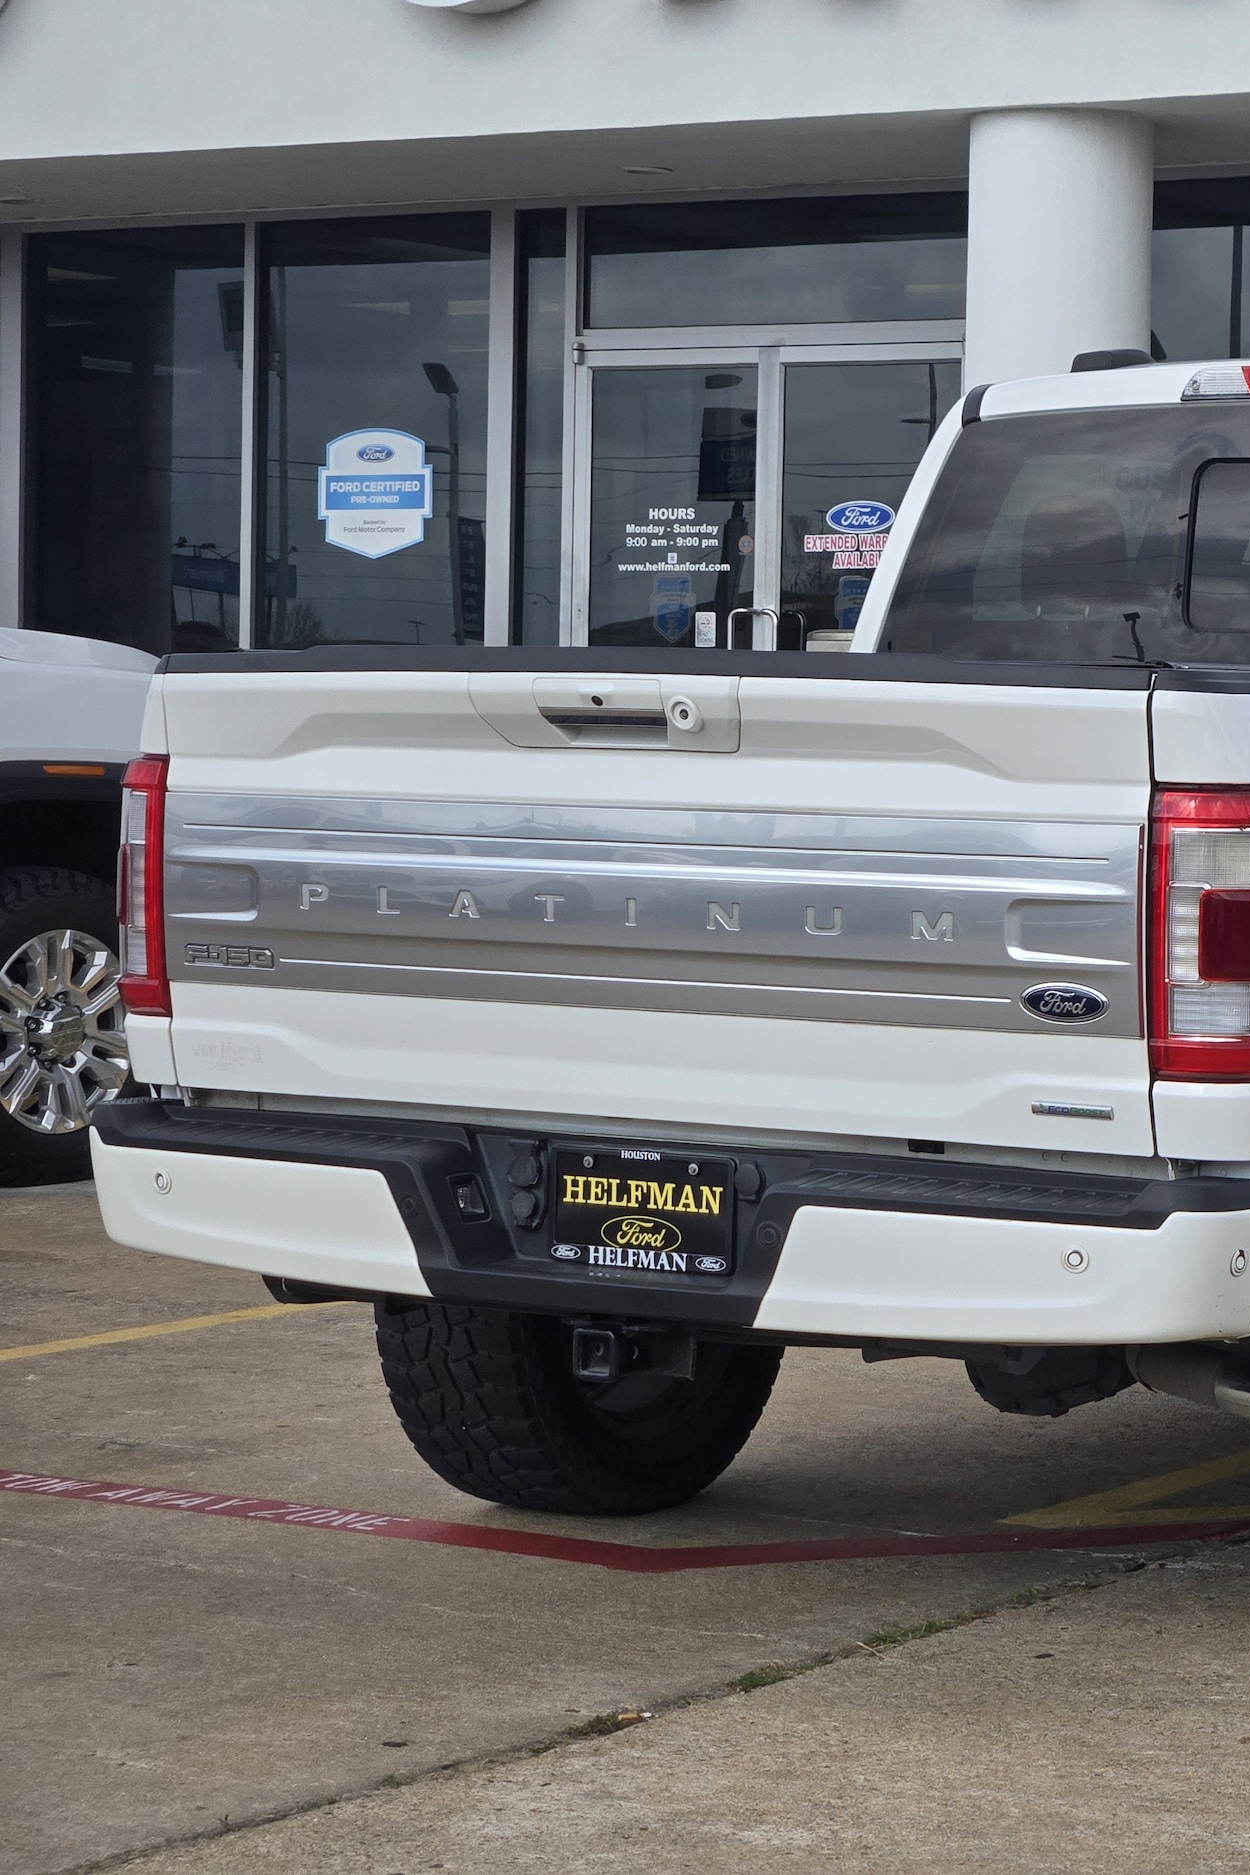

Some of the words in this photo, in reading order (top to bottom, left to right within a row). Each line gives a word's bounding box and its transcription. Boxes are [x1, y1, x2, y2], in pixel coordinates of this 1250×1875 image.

[362, 446, 389, 460] Ford
[330, 482, 361, 492] FORD
[362, 481, 420, 492] CERTIFIED
[350, 495, 400, 504] PRE-OWNED
[649, 508, 696, 520] HOURS
[840, 506, 881, 526] Ford
[376, 526, 405, 534] Company
[625, 523, 665, 535] Monday
[673, 523, 719, 535] Saturday
[626, 537, 648, 547] 9:00
[650, 538, 667, 547] am
[676, 537, 700, 547] 9:00
[701, 538, 719, 549] pm
[804, 535, 857, 551] EXTENDED
[859, 534, 889, 550] WARR
[618, 561, 731, 572] www.helfmanford.com
[832, 552, 879, 568] AVAILAB
[300, 882, 955, 942] PLATINUM
[184, 943, 275, 971] F-150
[1039, 990, 1088, 1014] Ford
[621, 1150, 661, 1162] HOUSTON
[562, 1175, 723, 1214] HELFMAN
[616, 1219, 667, 1248] Ford
[588, 1245, 687, 1272] HELFMAN
[0, 1473, 100, 1492] TOW
[86, 1488, 260, 1510] AWAY
[246, 1504, 410, 1531] ZONE
